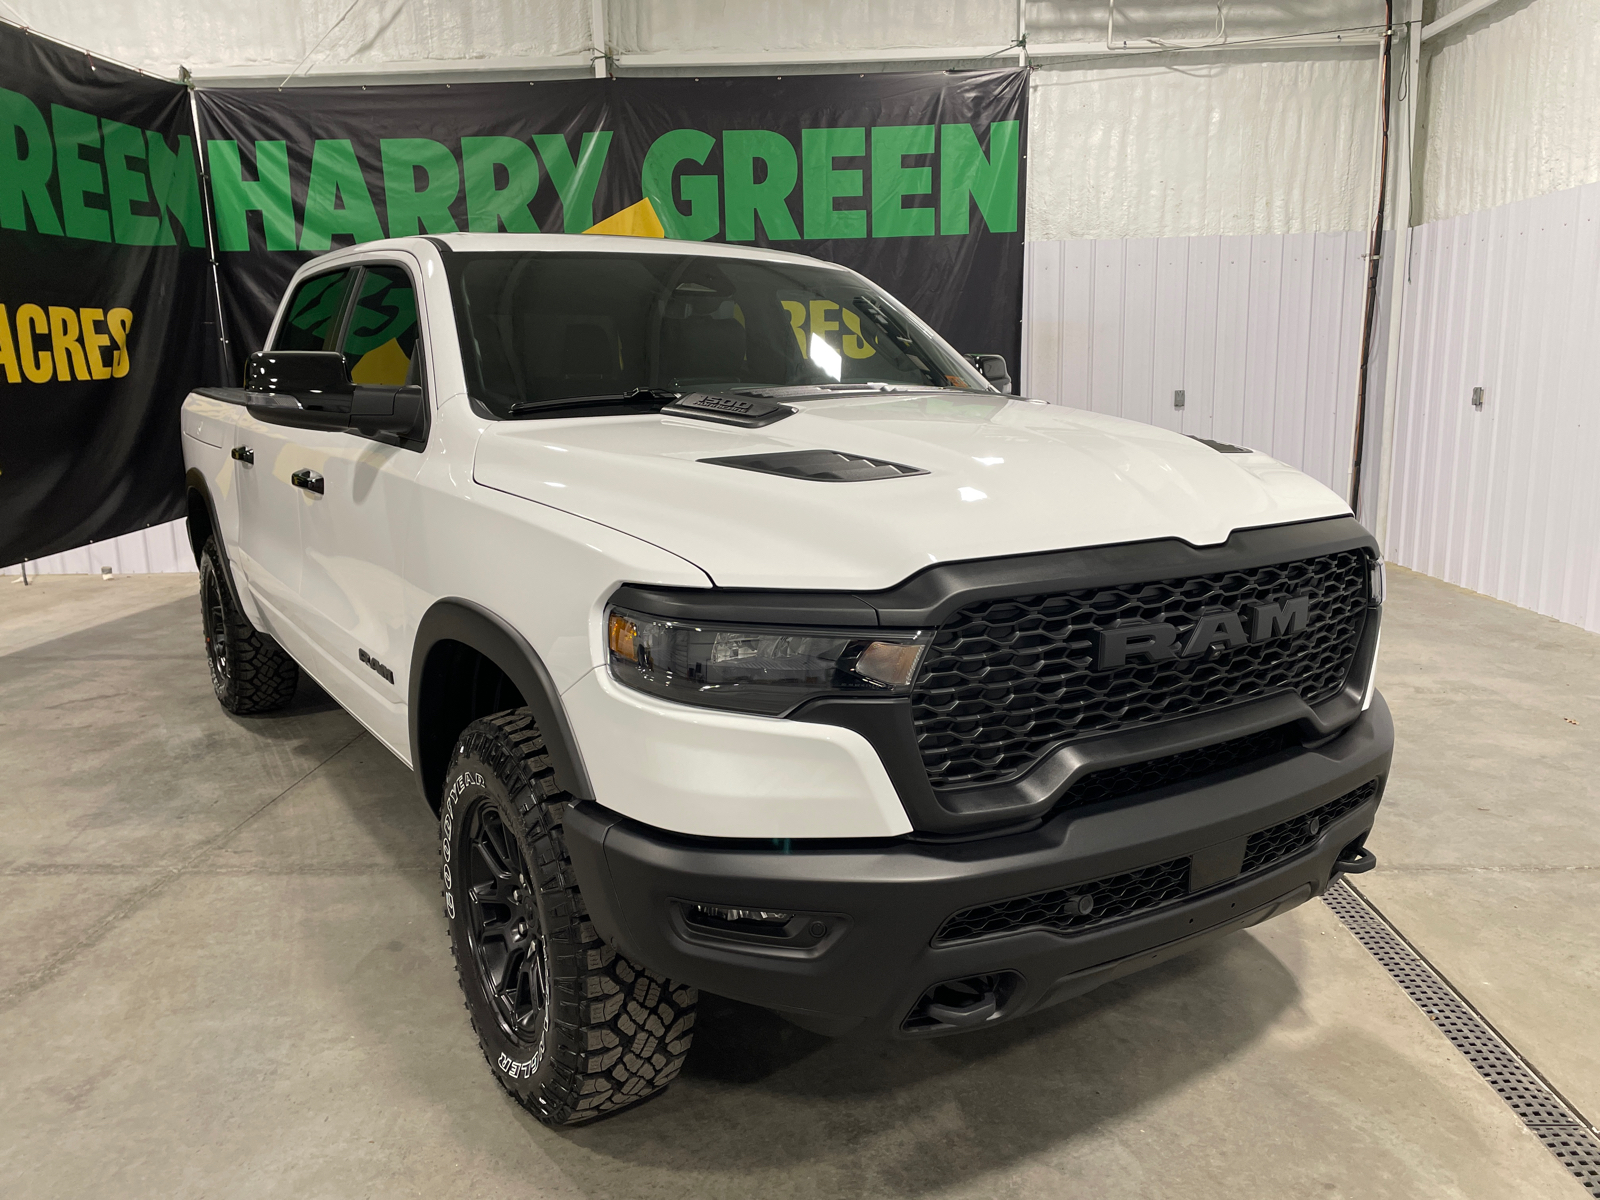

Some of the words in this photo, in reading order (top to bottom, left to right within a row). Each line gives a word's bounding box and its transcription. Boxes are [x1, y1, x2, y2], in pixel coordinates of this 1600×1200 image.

[207, 131, 613, 252] HARRY
[641, 120, 1019, 242] GREEN
[780, 299, 879, 361] RES
[1098, 595, 1309, 671] RAM
[442, 771, 486, 920] GOODYEAR
